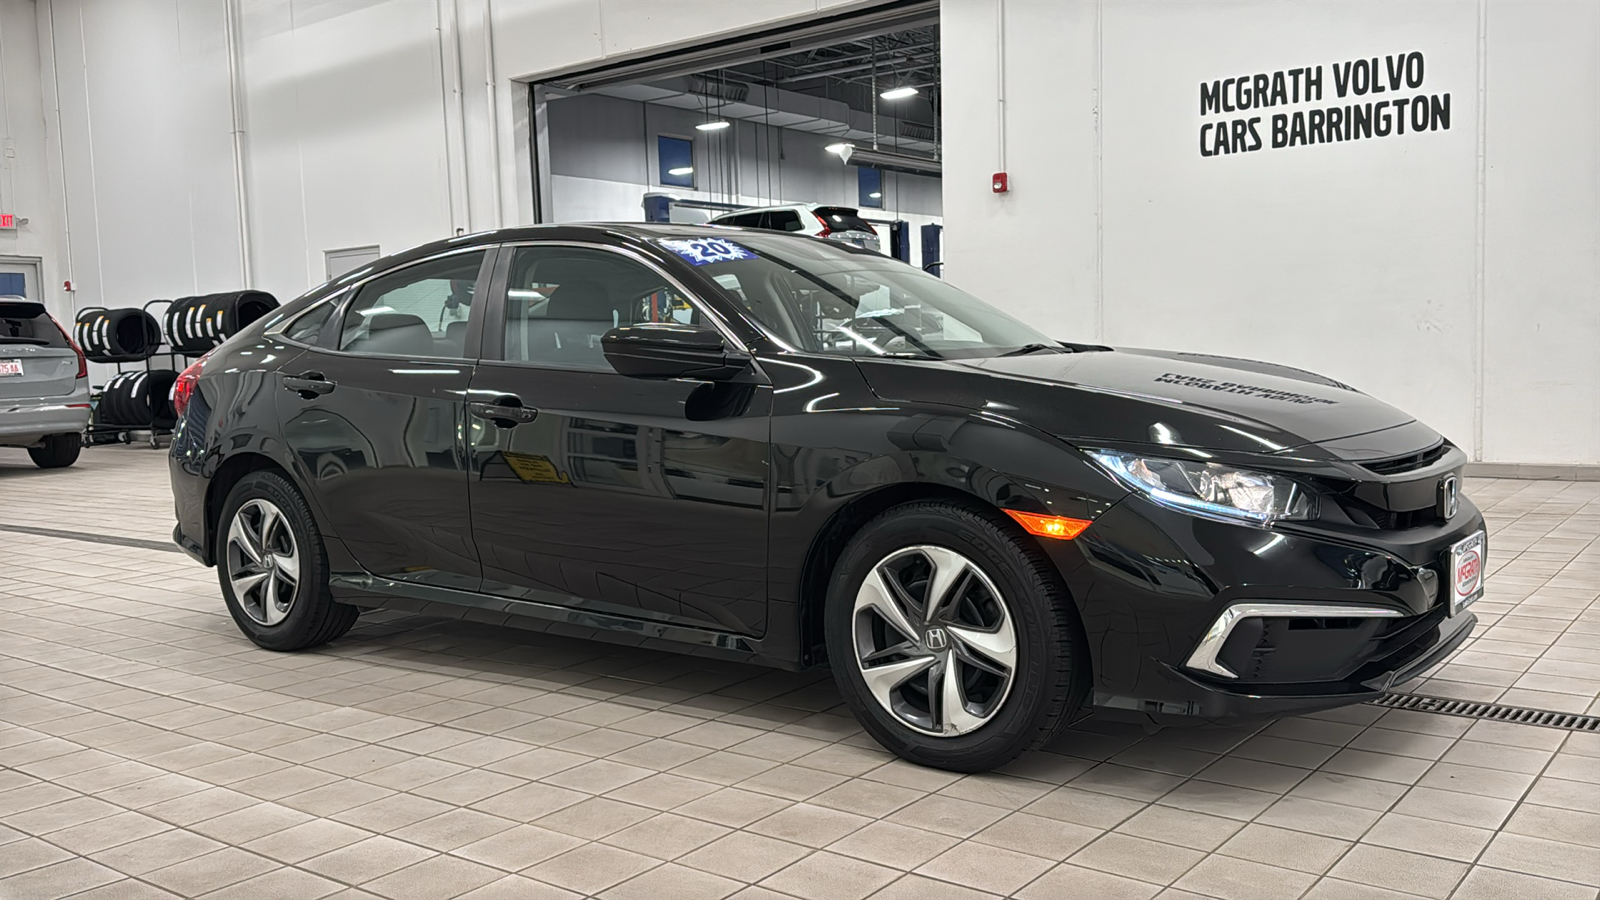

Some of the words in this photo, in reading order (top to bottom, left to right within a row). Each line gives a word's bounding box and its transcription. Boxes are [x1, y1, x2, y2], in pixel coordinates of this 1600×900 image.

[1200, 65, 1323, 116] MCGRATH
[1332, 51, 1424, 98] VOLVO
[1199, 116, 1263, 157] CARS
[1271, 93, 1451, 149] BARRINGTON
[690, 241, 732, 258] 20
[0, 363, 9, 373] 75
